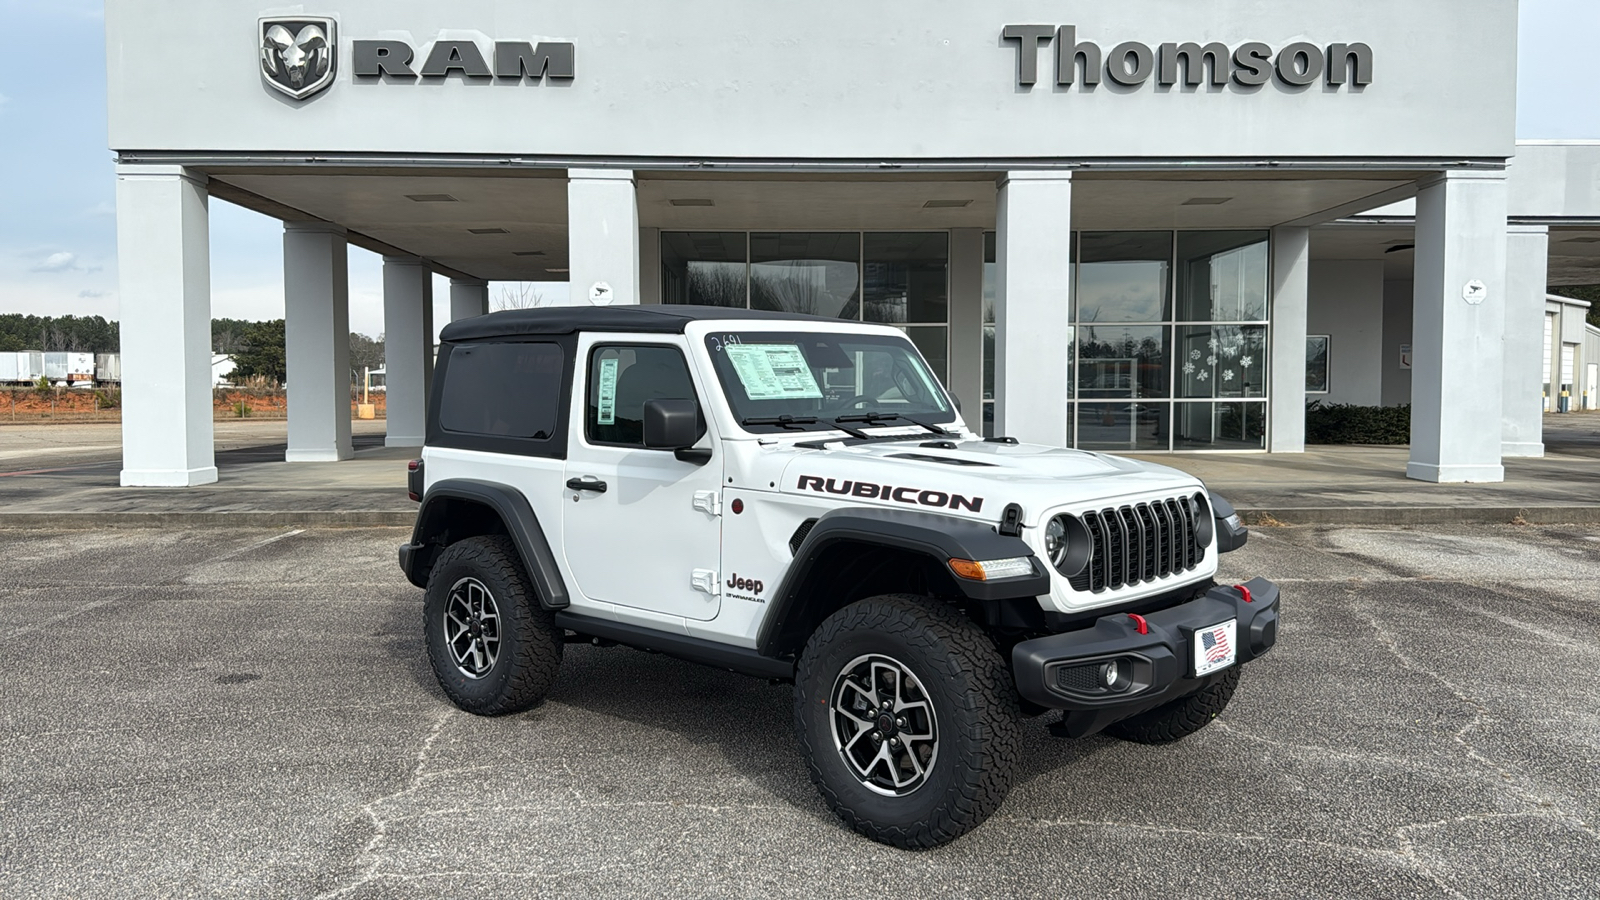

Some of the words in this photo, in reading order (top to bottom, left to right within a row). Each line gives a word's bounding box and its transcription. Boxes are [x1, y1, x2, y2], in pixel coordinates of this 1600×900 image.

[352, 40, 575, 80] RAM
[1003, 24, 1373, 89] Thomson
[797, 475, 984, 513] RUBICON
[726, 572, 764, 596] Jeep
[732, 593, 766, 604] WRANGLER
